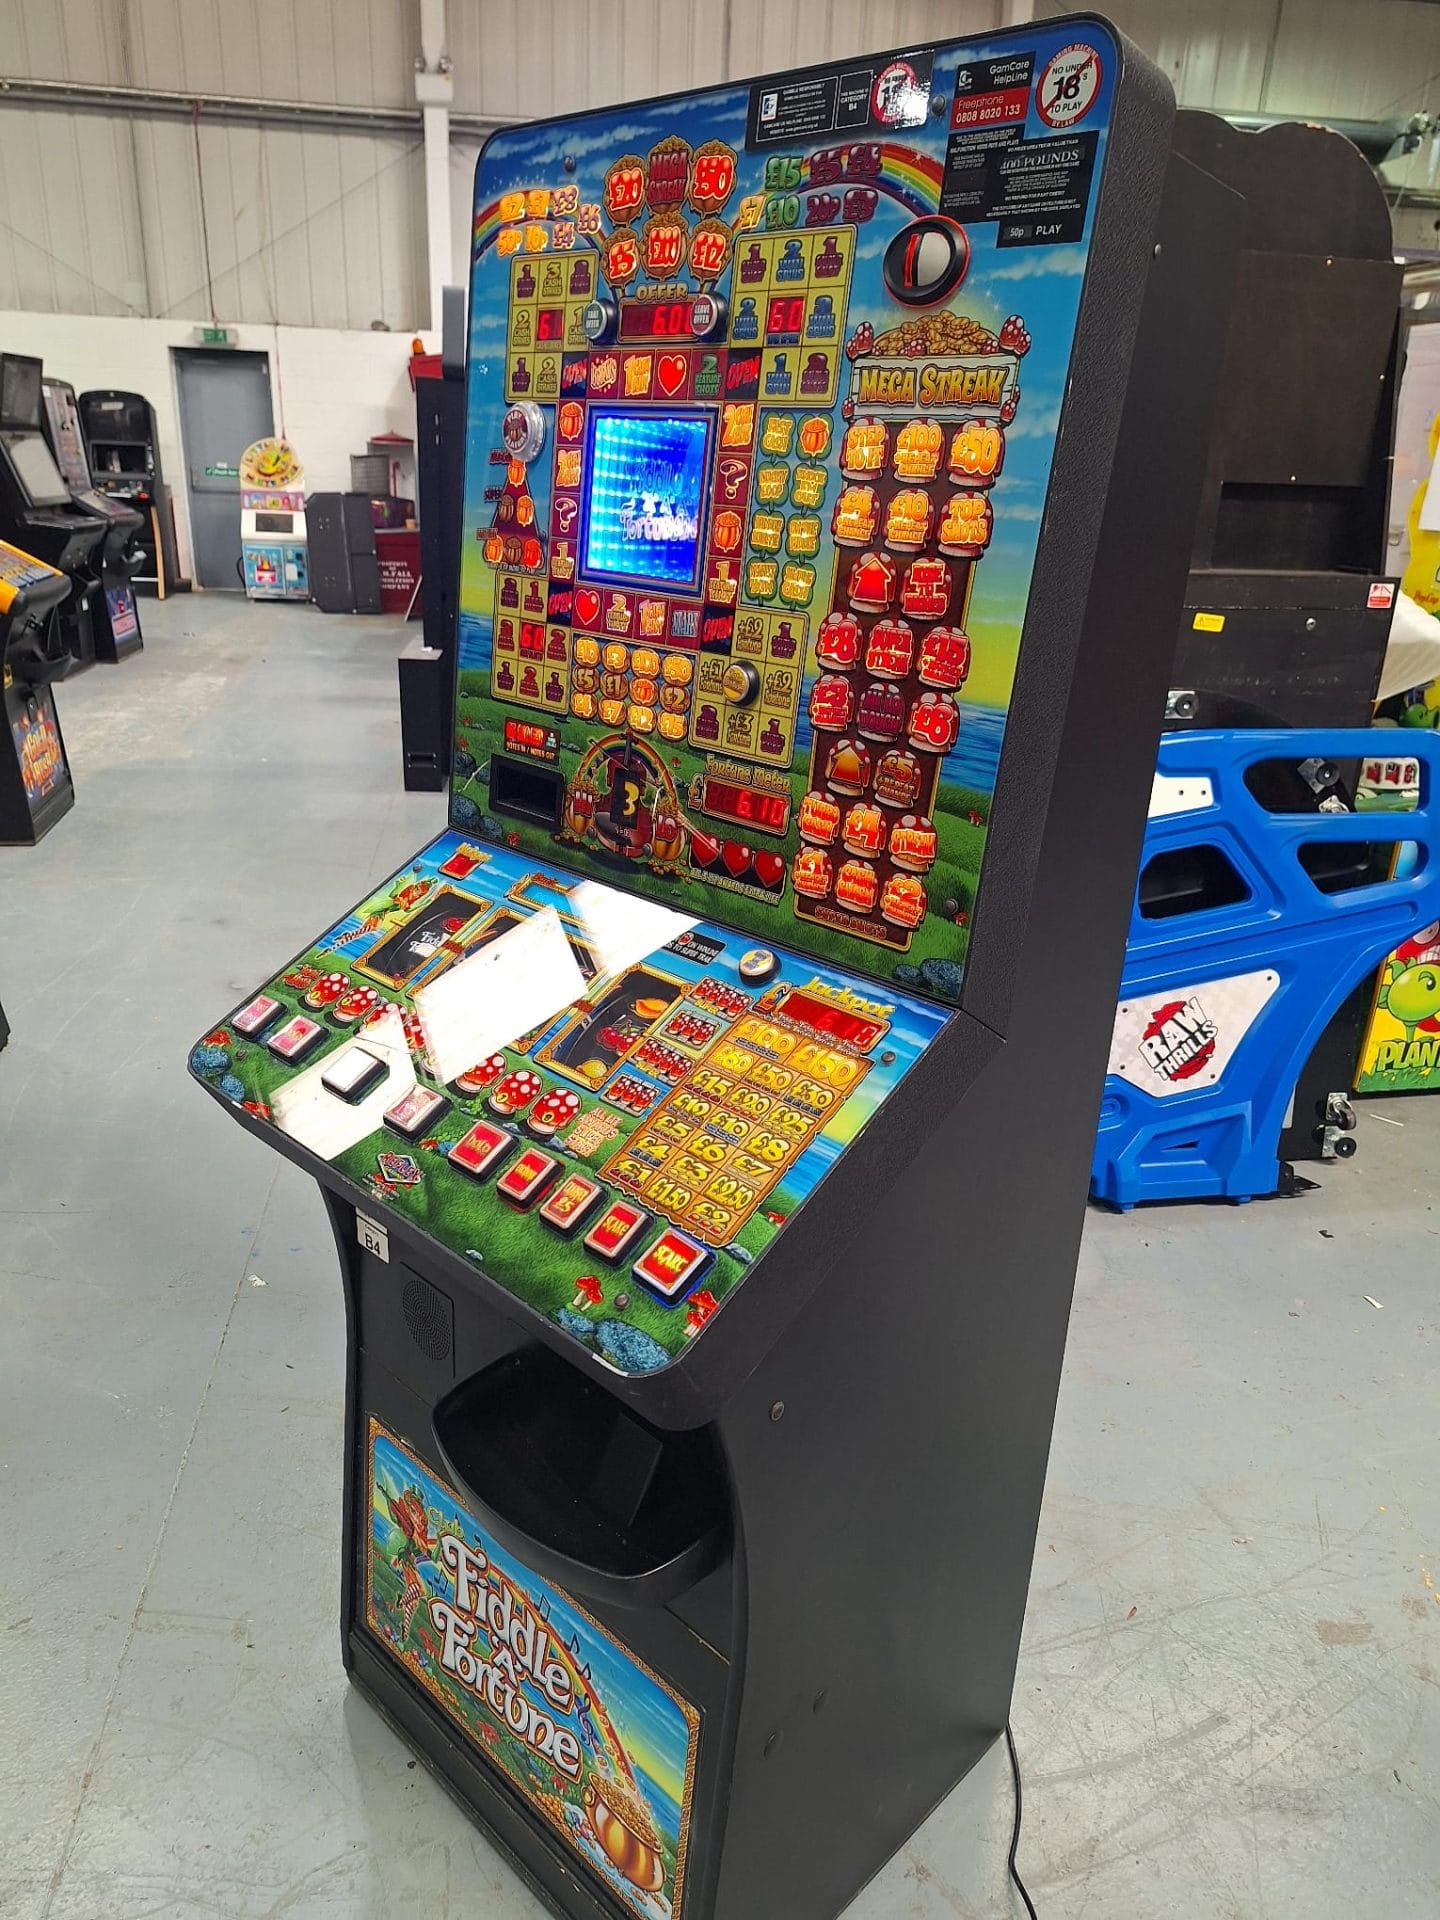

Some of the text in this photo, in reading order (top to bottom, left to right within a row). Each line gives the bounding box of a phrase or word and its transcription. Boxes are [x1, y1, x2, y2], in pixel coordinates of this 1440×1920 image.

[989, 60, 1030, 75] GamCare
[993, 71, 1028, 87] HelpLine
[1051, 65, 1064, 75] NO
[840, 94, 867, 104] CATEGORY
[958, 94, 1004, 111] Freephone
[1050, 100, 1083, 114] TO PLAY
[956, 103, 1021, 124] 0808 8020 133
[1024, 149, 1080, 167] POUNDS
[765, 155, 804, 191] £15
[766, 195, 801, 230] £10
[1009, 224, 1062, 238] 50p PLAY
[784, 238, 803, 259] 2
[544, 278, 562, 288] CASH
[546, 261, 562, 279] 3
[636, 283, 690, 302] OFFER
[516, 310, 531, 328] 2
[693, 314, 710, 325] OFFER
[694, 303, 710, 315] LEAVE
[514, 328, 531, 338] CASH
[538, 374, 555, 384] CASH
[541, 357, 555, 376] 2
[726, 355, 760, 390] OPEN
[858, 364, 1010, 408] MEGA STREAK
[847, 425, 886, 449] STEP
[896, 424, 942, 453] £100
[951, 427, 1001, 475] £50
[888, 493, 929, 523] £10
[949, 498, 986, 522] TOP
[941, 519, 988, 544] SHOTS
[703, 615, 733, 642] OPEN
[822, 620, 857, 663] £8
[664, 686, 685, 711] £2
[912, 702, 954, 746] £6
[530, 747, 545, 758] NOTES
[545, 750, 556, 761] OUT
[705, 753, 791, 793] Fortune Meter
[881, 755, 914, 784] £5
[622, 780, 640, 818] 3
[688, 773, 704, 810] £
[845, 809, 882, 844] £4
[673, 943, 681, 952] TO
[681, 945, 698, 959] SUPER
[686, 940, 697, 950] ON
[694, 999, 719, 1015] SUPER
[753, 983, 792, 1016] £
[1138, 996, 1208, 1069] RAW
[735, 1018, 859, 1087] £100 £150
[1153, 1020, 1219, 1081] THRILLS
[1375, 1040, 1440, 1073] PLAN
[749, 1062, 796, 1092] £50
[788, 1079, 834, 1108] £30
[690, 1069, 815, 1137] £15 £20 £25
[654, 1114, 775, 1178] £5 £6 £7
[708, 1111, 791, 1163] £10 £8
[634, 1135, 714, 1182] £4 £3
[556, 1196, 576, 1213] £5
[617, 1159, 732, 1230] £1 £2
[364, 1232, 381, 1255] B4
[653, 1245, 689, 1273] START
[441, 1533, 574, 1712] Fiddle
[431, 1600, 580, 1779] Fortune
